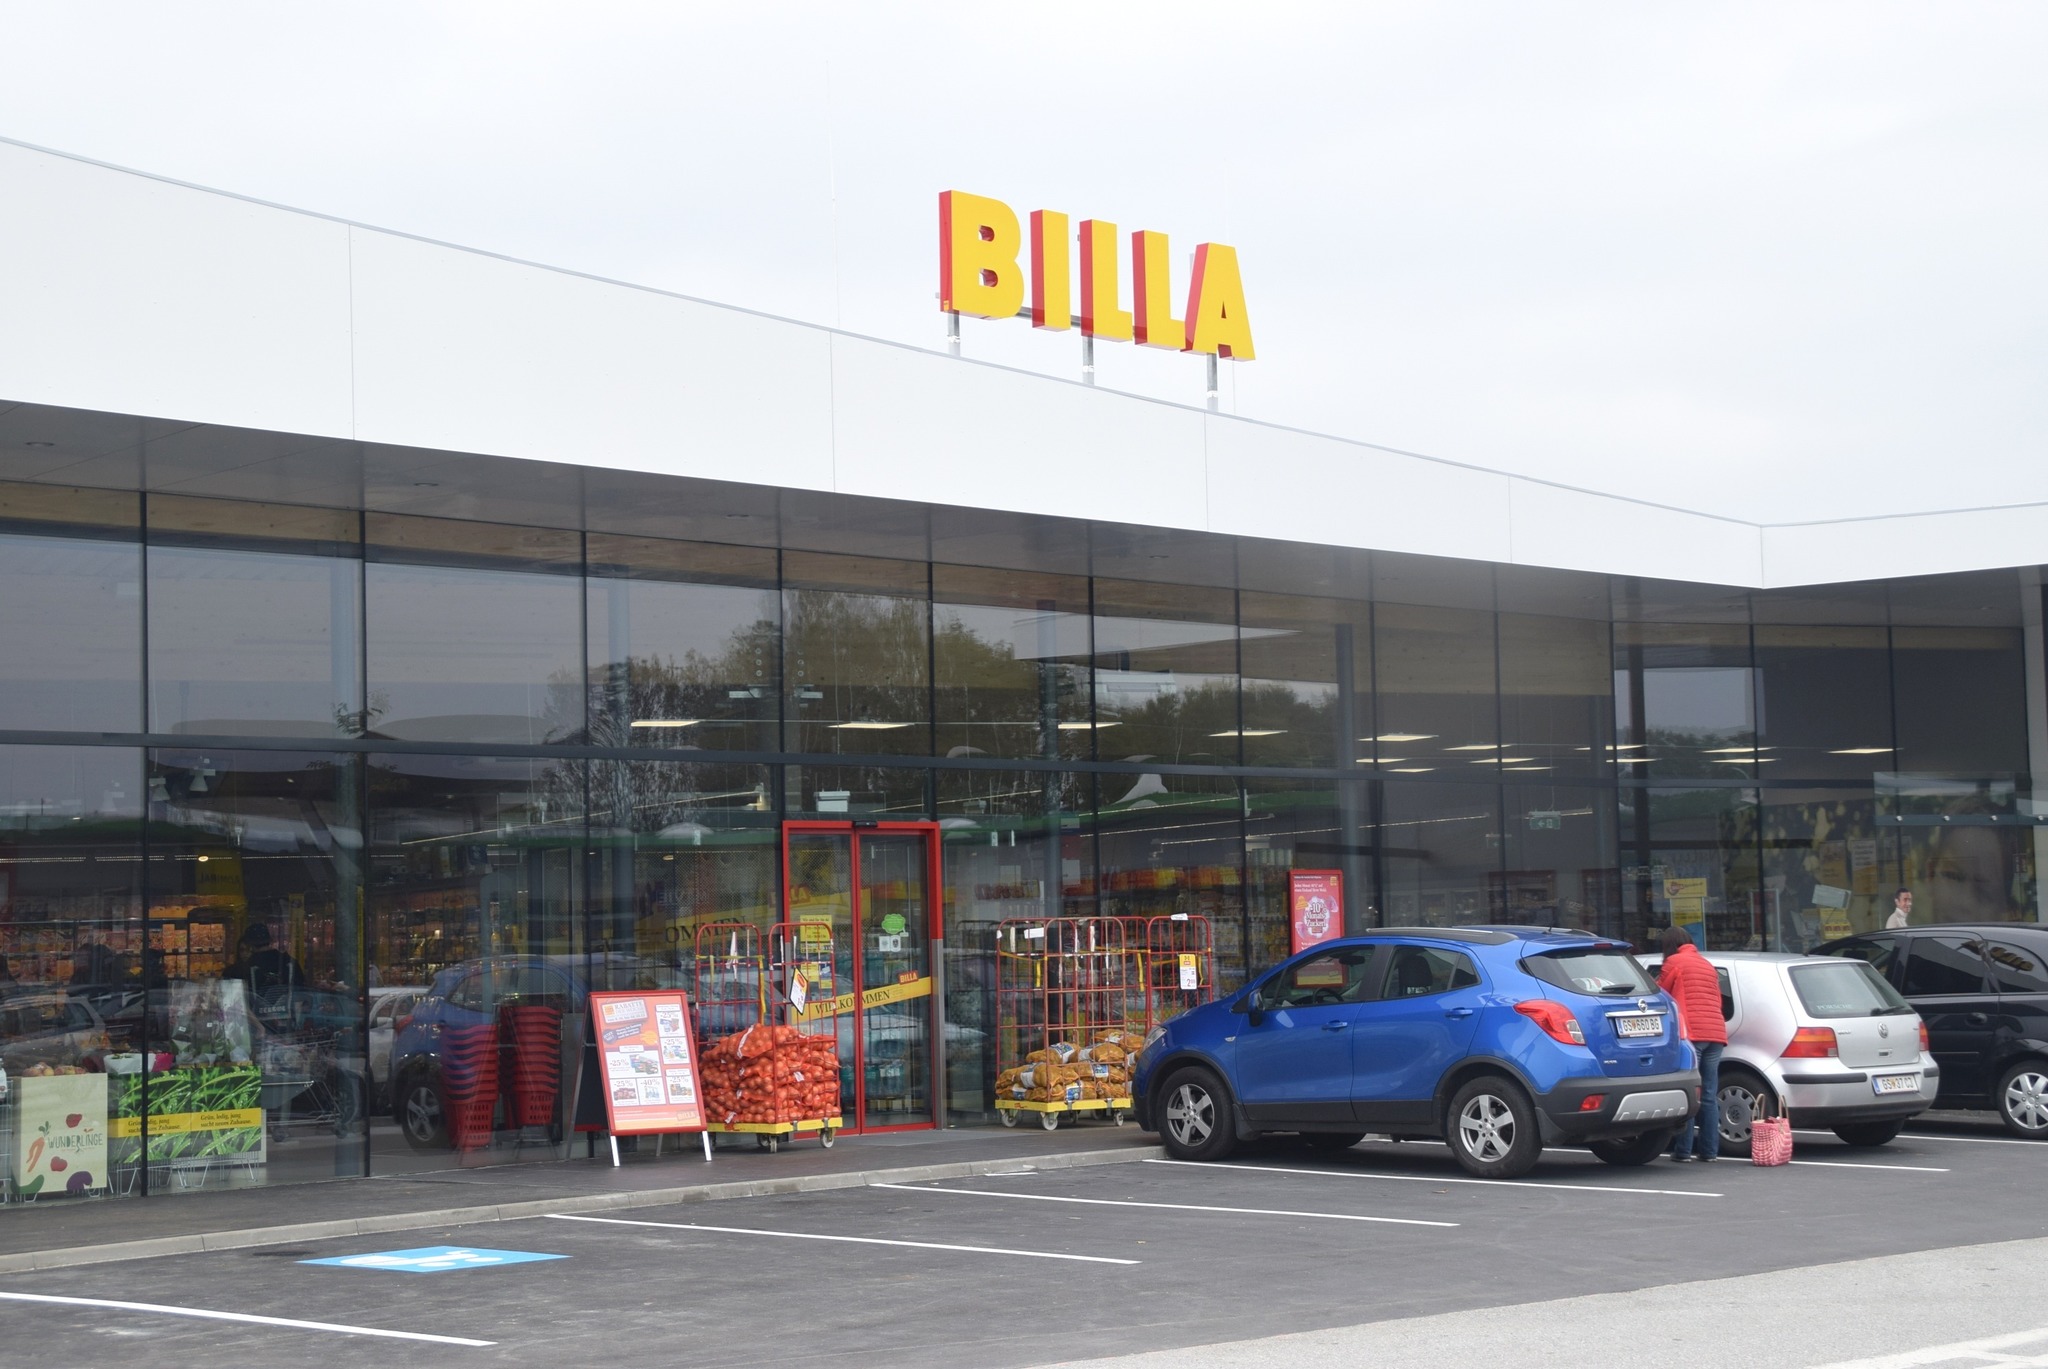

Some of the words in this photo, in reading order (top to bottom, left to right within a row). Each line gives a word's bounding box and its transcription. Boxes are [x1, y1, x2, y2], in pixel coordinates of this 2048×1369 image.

[939, 190, 1256, 361] BILLA
[900, 972, 918, 983] BILLA
[1623, 1019, 1632, 1031] GS
[48, 1133, 103, 1150] WUNDERLINGE
